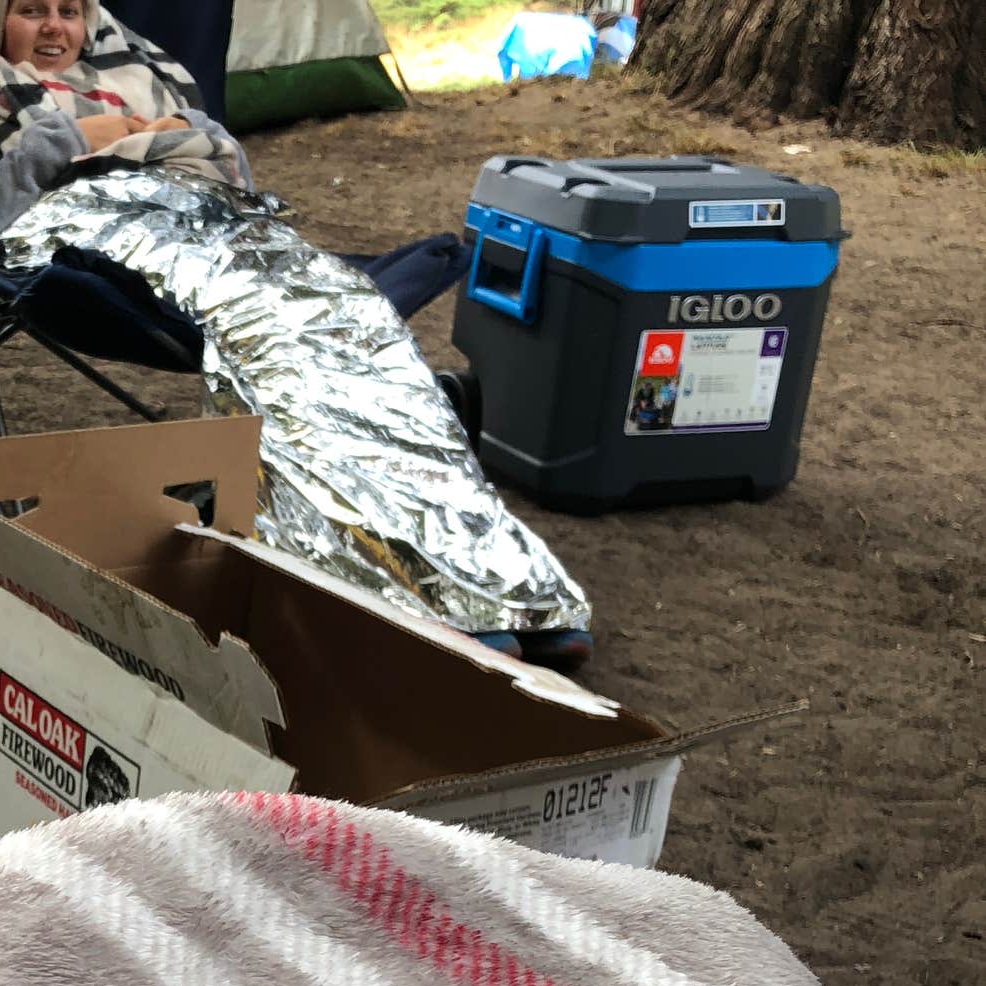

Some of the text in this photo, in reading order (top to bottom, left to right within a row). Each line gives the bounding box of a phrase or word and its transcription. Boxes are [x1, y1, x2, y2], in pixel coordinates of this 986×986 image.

[667, 293, 782, 322] IGLOO
[3, 683, 81, 763] CAL OAK
[2, 722, 76, 797] FIREWOOD
[542, 773, 612, 823] 01212F
